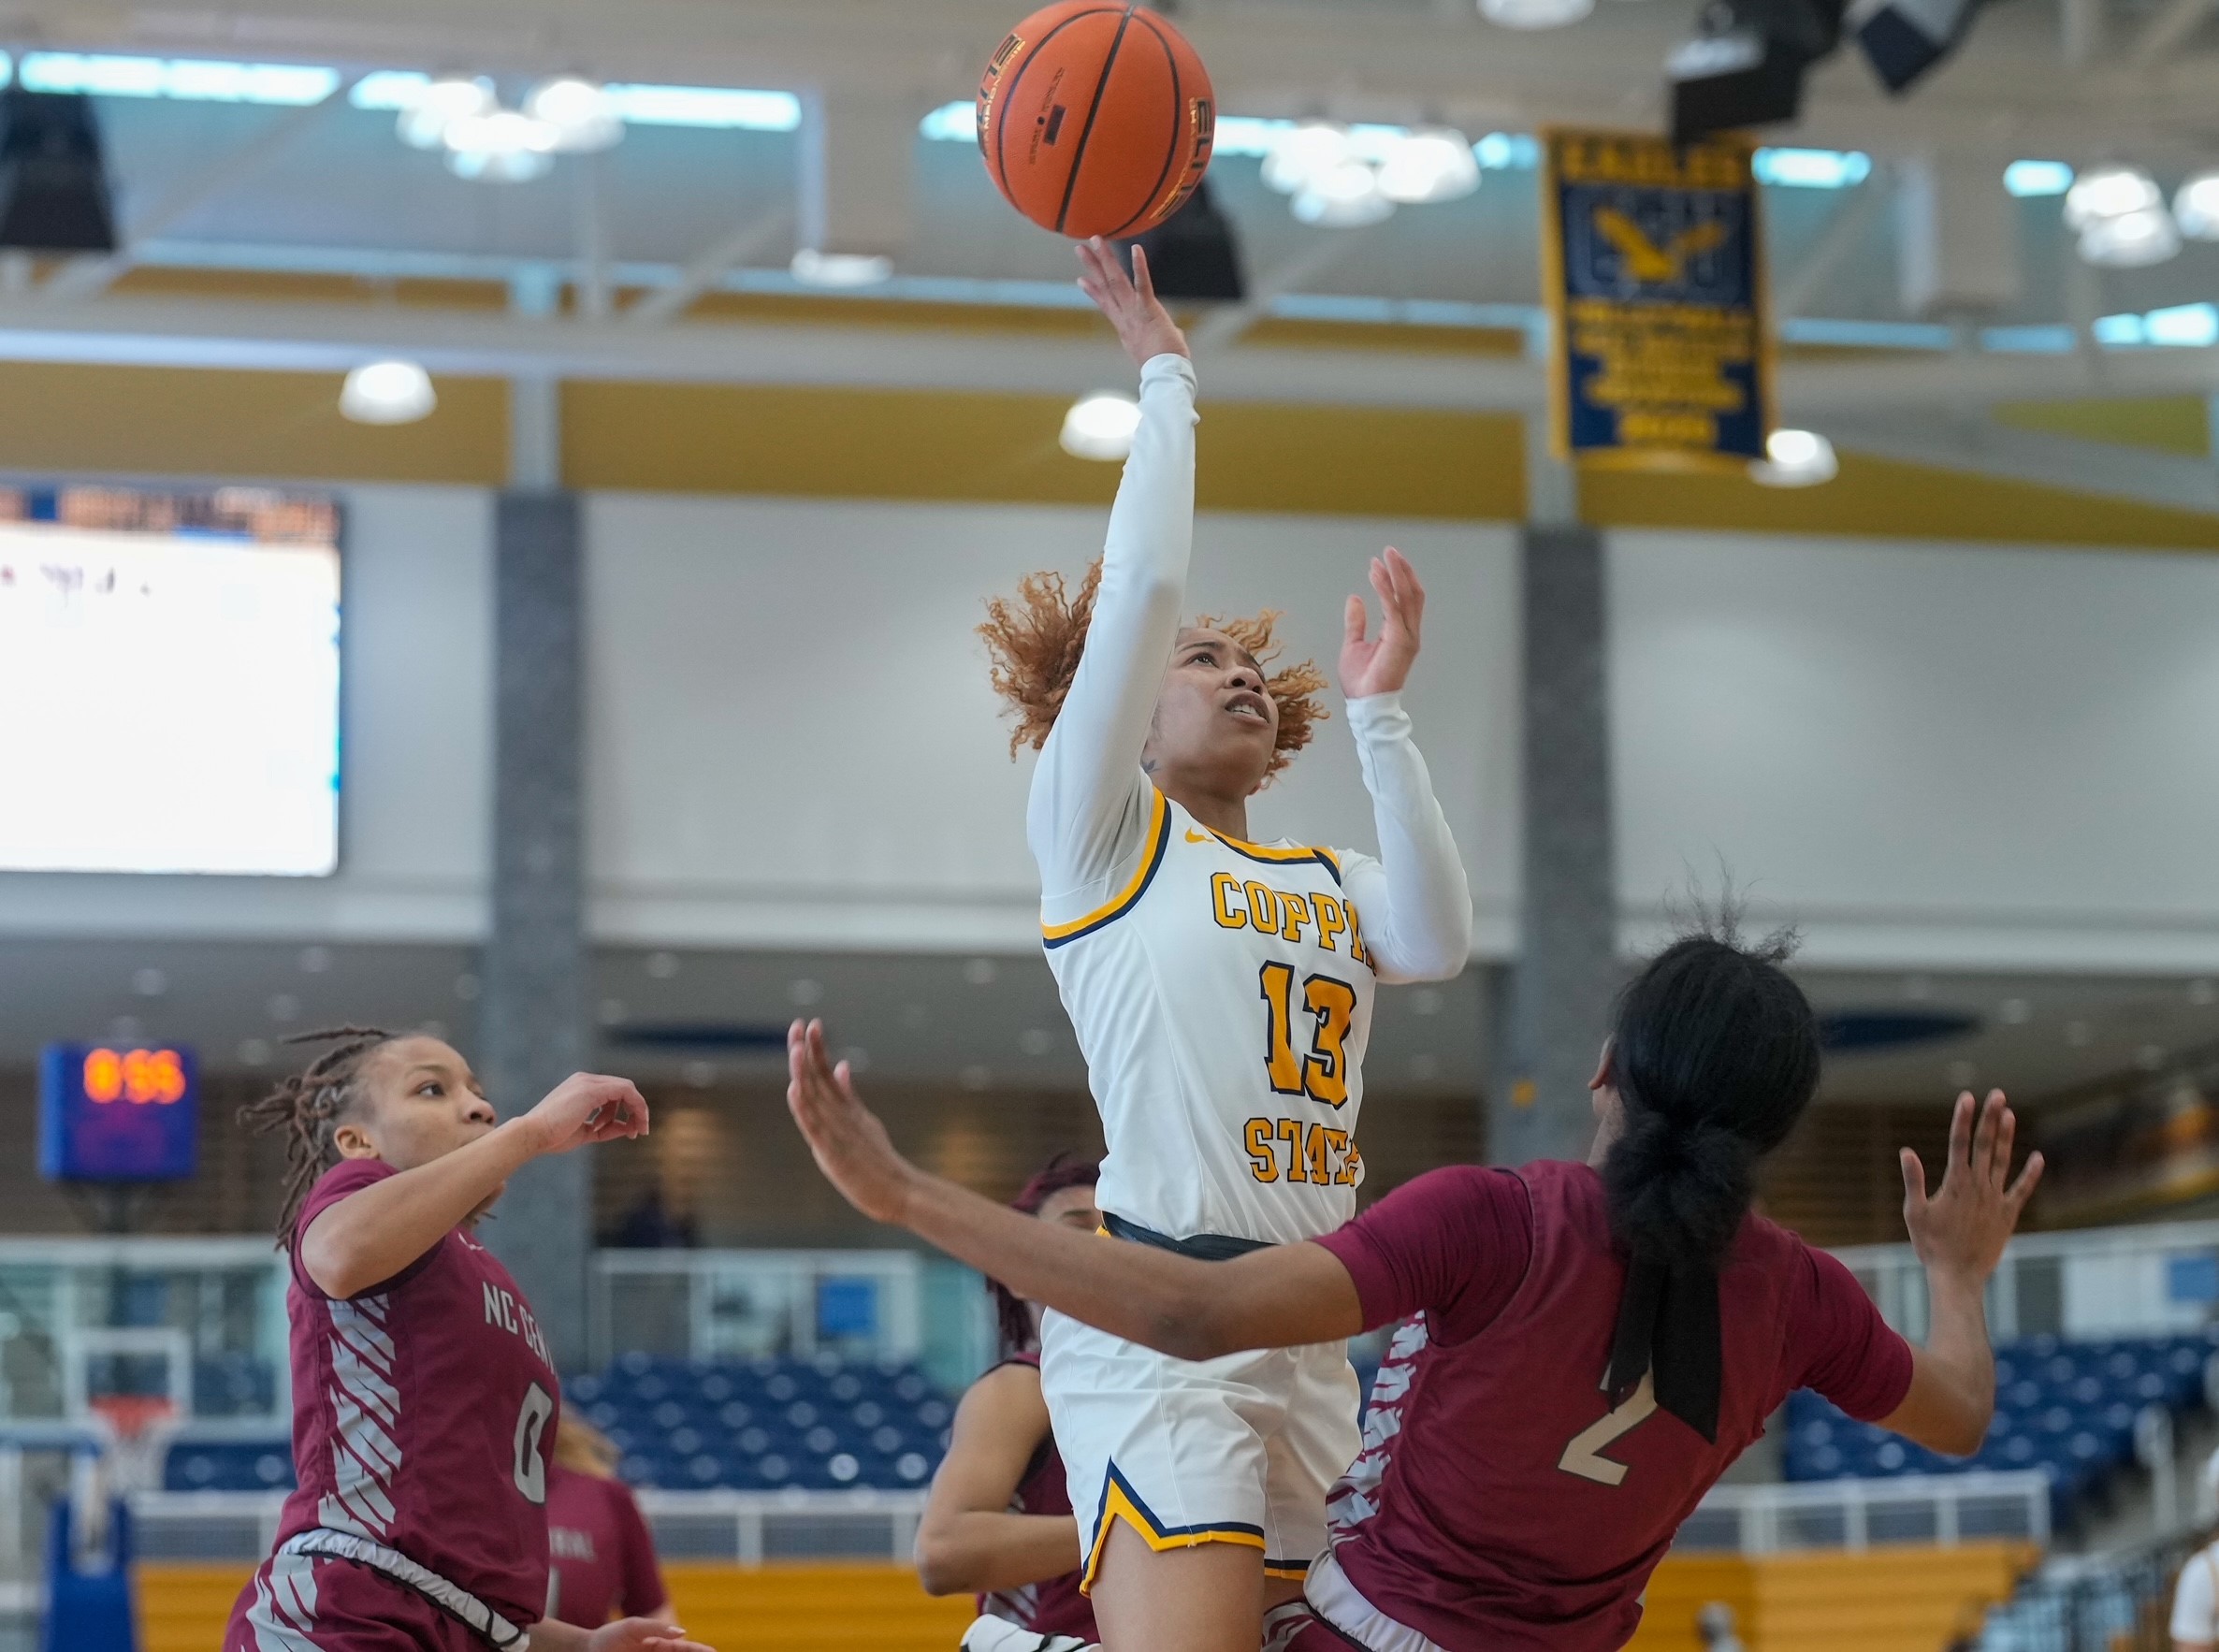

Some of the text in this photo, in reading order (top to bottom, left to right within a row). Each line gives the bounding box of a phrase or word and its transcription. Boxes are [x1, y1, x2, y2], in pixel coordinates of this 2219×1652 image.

[1210, 871, 1377, 978] COPPI
[1259, 960, 1357, 1110] 13
[1244, 1117, 1361, 1187] STATE
[483, 1281, 518, 1335] NC
[513, 1377, 554, 1508] 0
[1557, 1352, 1660, 1486] 2
